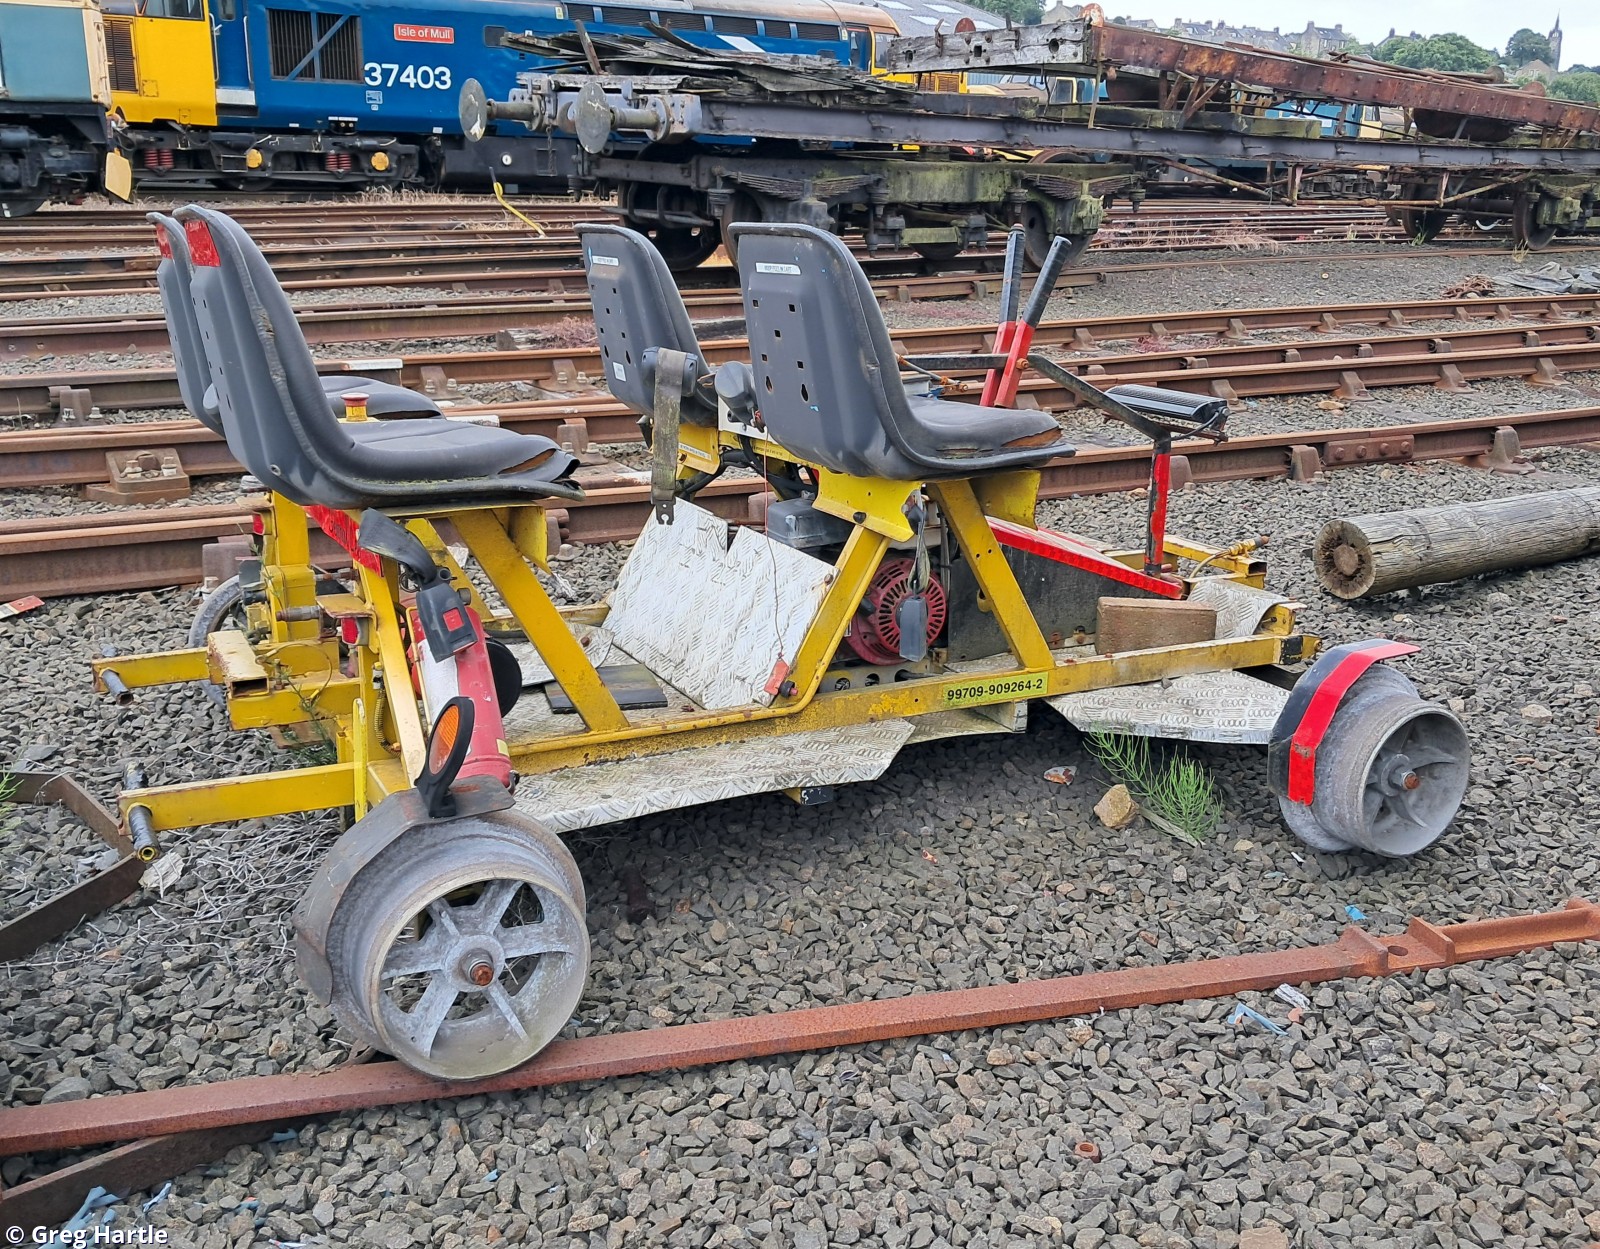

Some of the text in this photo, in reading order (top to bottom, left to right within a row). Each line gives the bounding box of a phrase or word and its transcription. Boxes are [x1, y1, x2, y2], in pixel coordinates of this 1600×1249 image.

[398, 26, 451, 39] Isle of Mull
[364, 62, 452, 90] 37403
[947, 678, 1043, 701] 99709-909264-2
